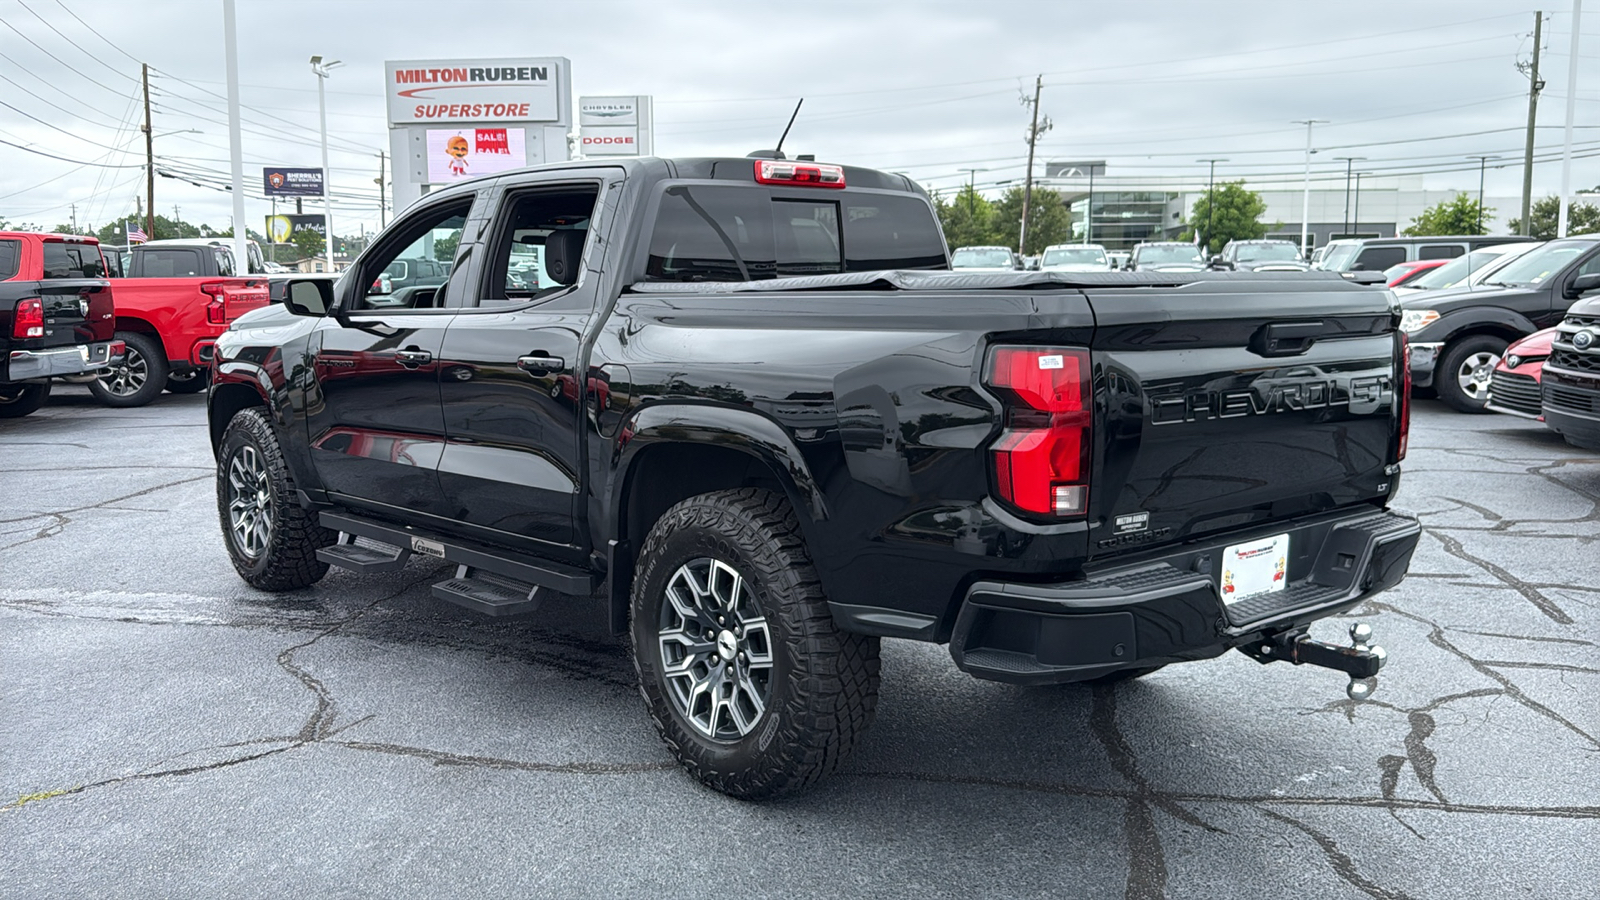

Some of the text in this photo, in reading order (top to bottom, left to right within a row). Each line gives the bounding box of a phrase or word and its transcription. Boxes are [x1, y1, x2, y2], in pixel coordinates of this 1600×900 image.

[414, 103, 530, 118] SUPERSTORE
[477, 133, 506, 141] SALE!
[1151, 374, 1392, 425] CHEVROLET
